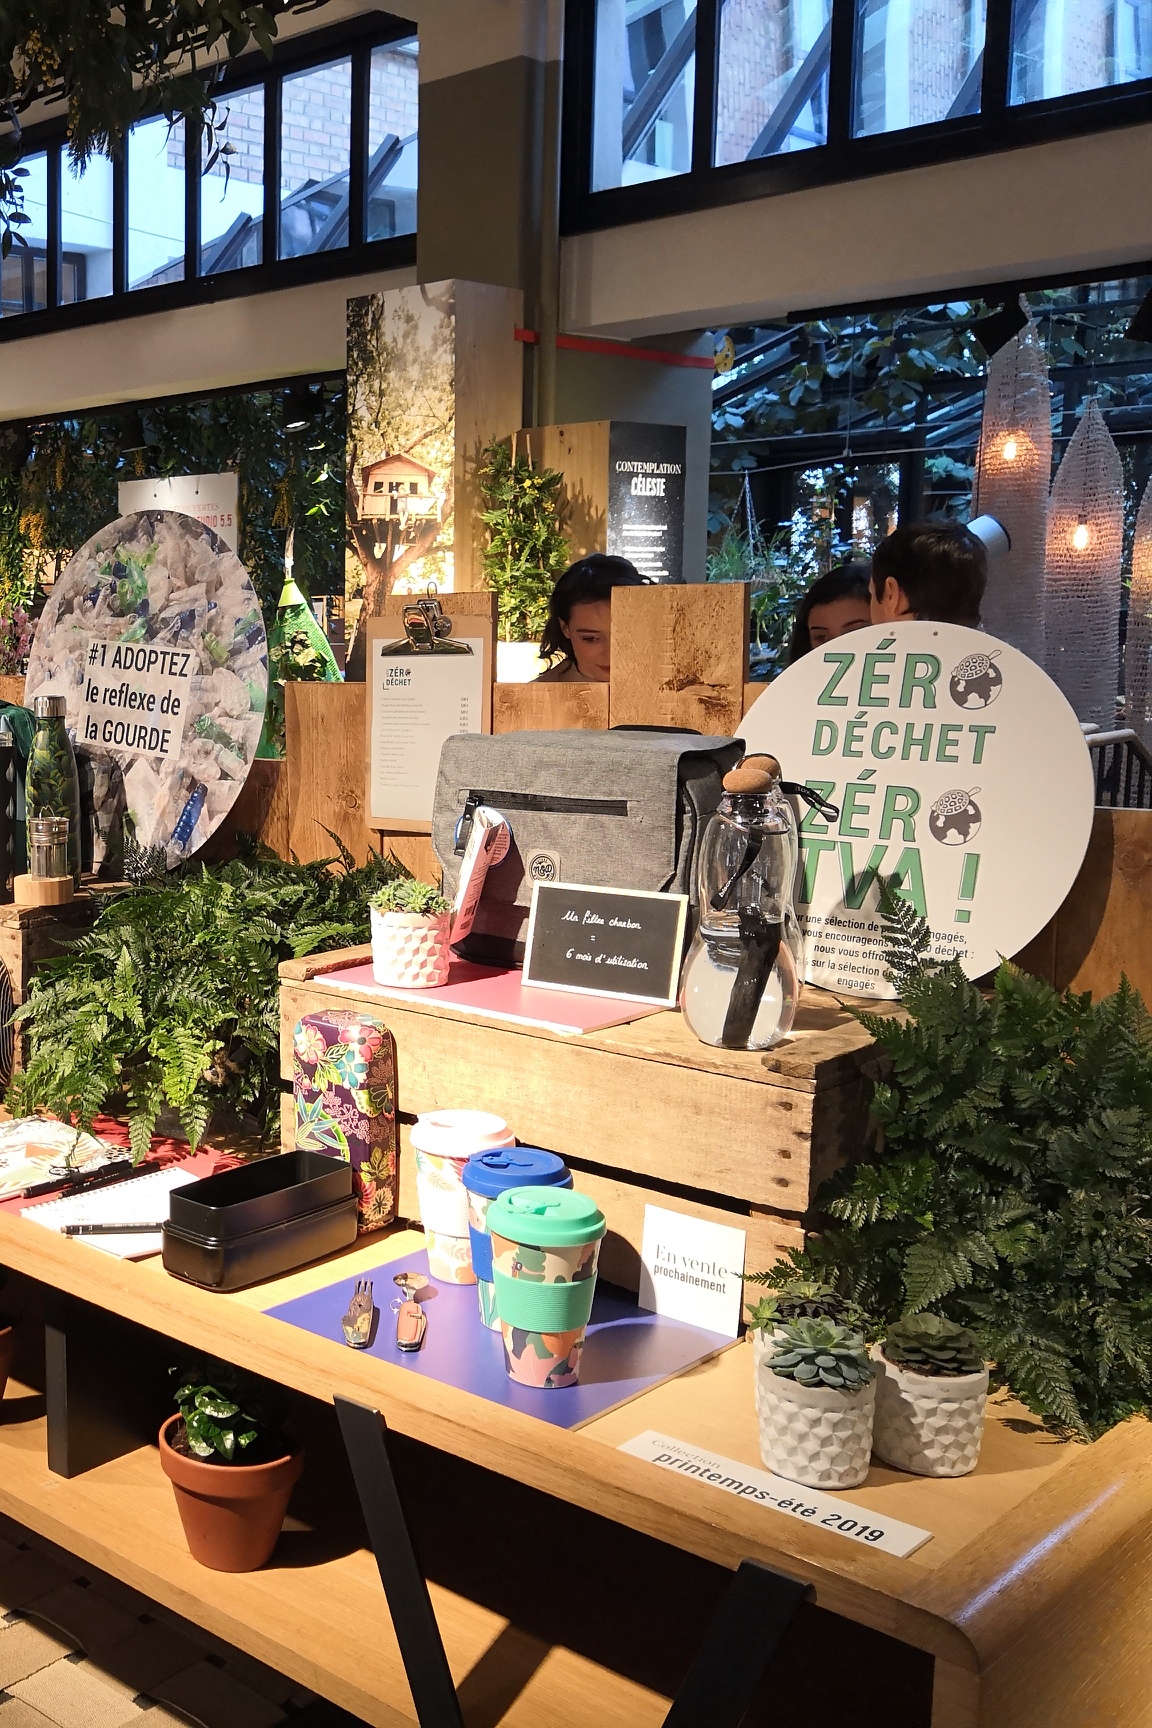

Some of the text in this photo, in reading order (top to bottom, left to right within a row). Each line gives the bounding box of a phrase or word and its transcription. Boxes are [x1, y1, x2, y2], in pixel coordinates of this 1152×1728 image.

[616, 461, 682, 474] CONTEMPLATION
[631, 474, 666, 496] CÉLESTE
[195, 513, 232, 527] TUDIO 5.5
[88, 643, 190, 677] #1 ADOPTEZ
[85, 678, 181, 715] le reflexe de
[386, 678, 411, 686] DÉCHET
[85, 715, 171, 753] la GOURDE
[812, 711, 996, 764] DÉCHET
[799, 837, 928, 918] TVA
[561, 910, 579, 922] Un
[609, 917, 642, 929] charbon
[806, 916, 822, 924] une
[824, 916, 865, 930] sélection
[867, 921, 879, 931] de
[929, 931, 967, 945] ngagés,
[566, 948, 575, 959] 6
[576, 953, 592, 962] mois
[802, 929, 822, 938] vous
[825, 932, 889, 947] encourageons
[935, 944, 968, 958] déchet
[814, 944, 893, 962] nous vous offrou
[811, 959, 825, 968] sur
[828, 960, 835, 969] la
[838, 962, 879, 976] sélection
[837, 977, 875, 990] engagés
[656, 1244, 728, 1279] En vente
[653, 1264, 726, 1294] prochainement
[652, 1439, 722, 1469] Collection
[652, 1453, 886, 1542] printemps-été 2019
